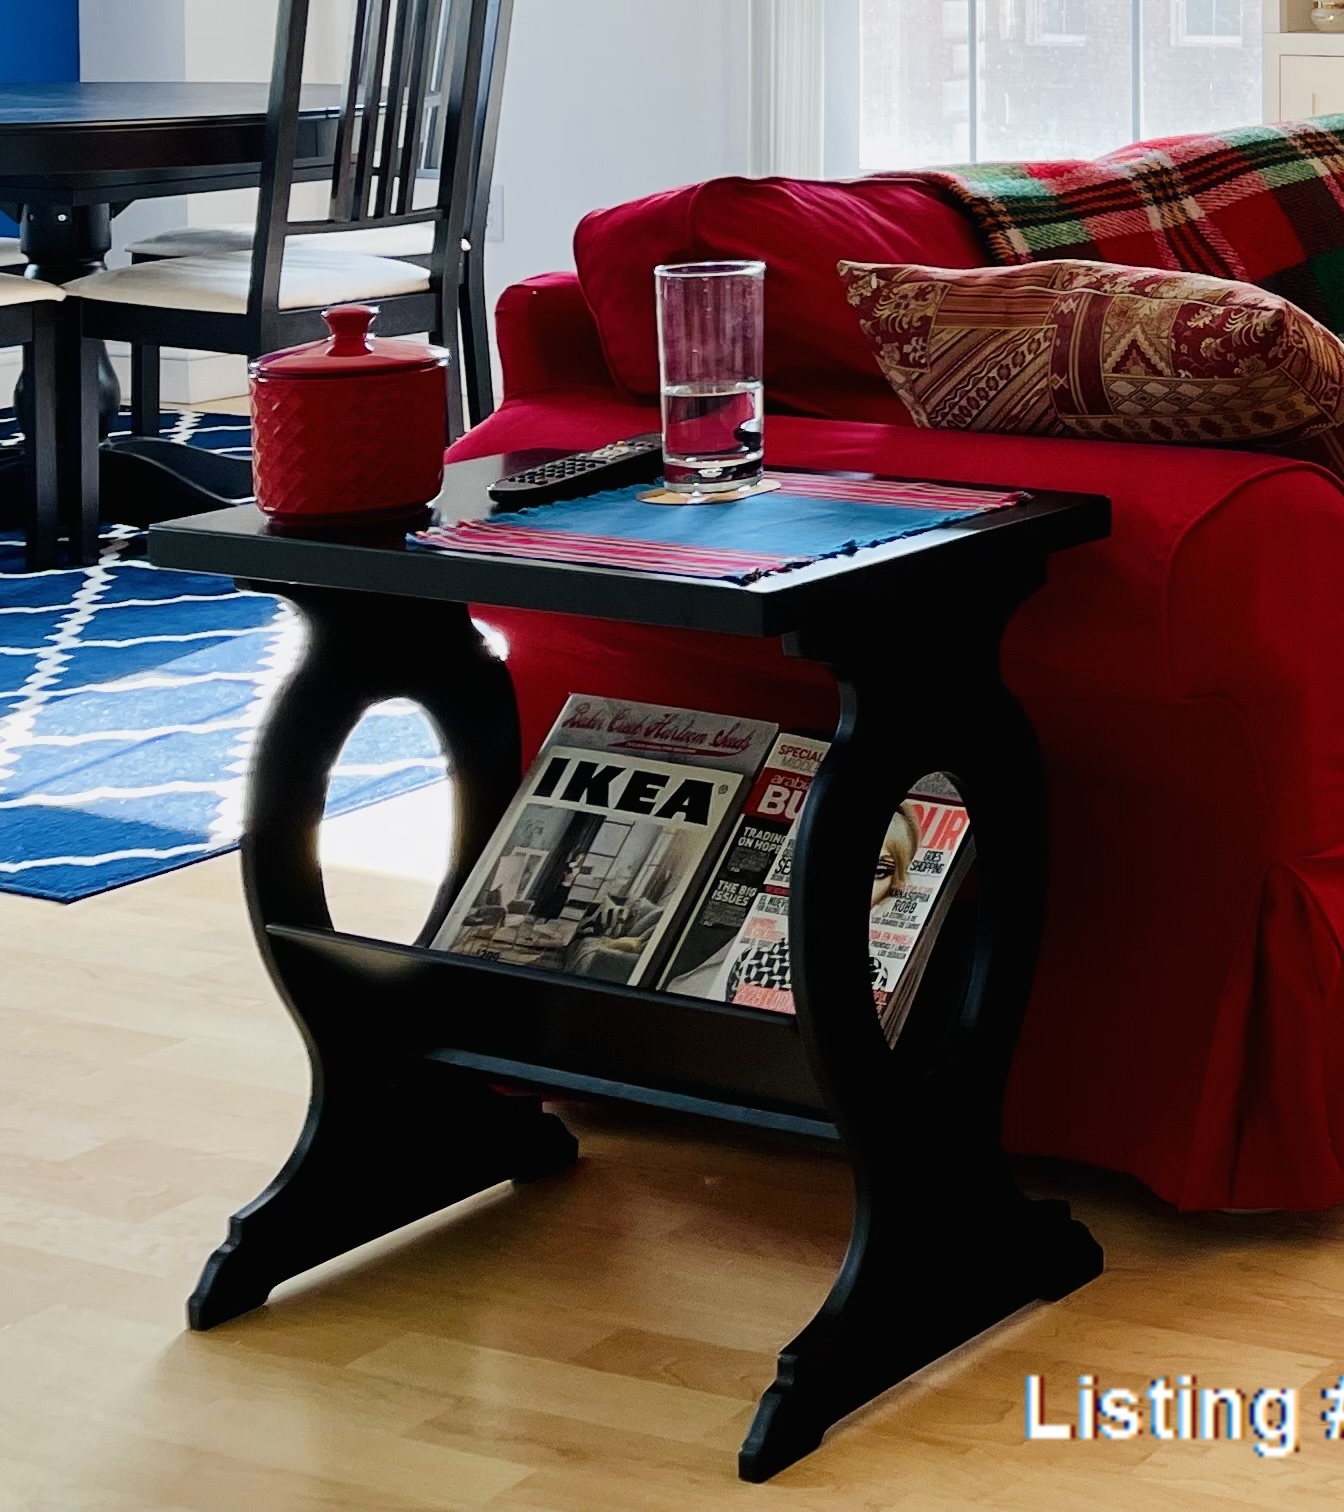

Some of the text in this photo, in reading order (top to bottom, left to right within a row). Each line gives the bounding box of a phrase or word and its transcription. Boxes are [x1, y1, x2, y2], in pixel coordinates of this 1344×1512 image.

[778, 744, 825, 763] SPECIAL
[533, 757, 715, 826] IKEA
[738, 837, 754, 849] ON
[717, 880, 758, 898] THE BIG
[711, 890, 750, 907] ISSUES
[891, 900, 917, 914] ROBB
